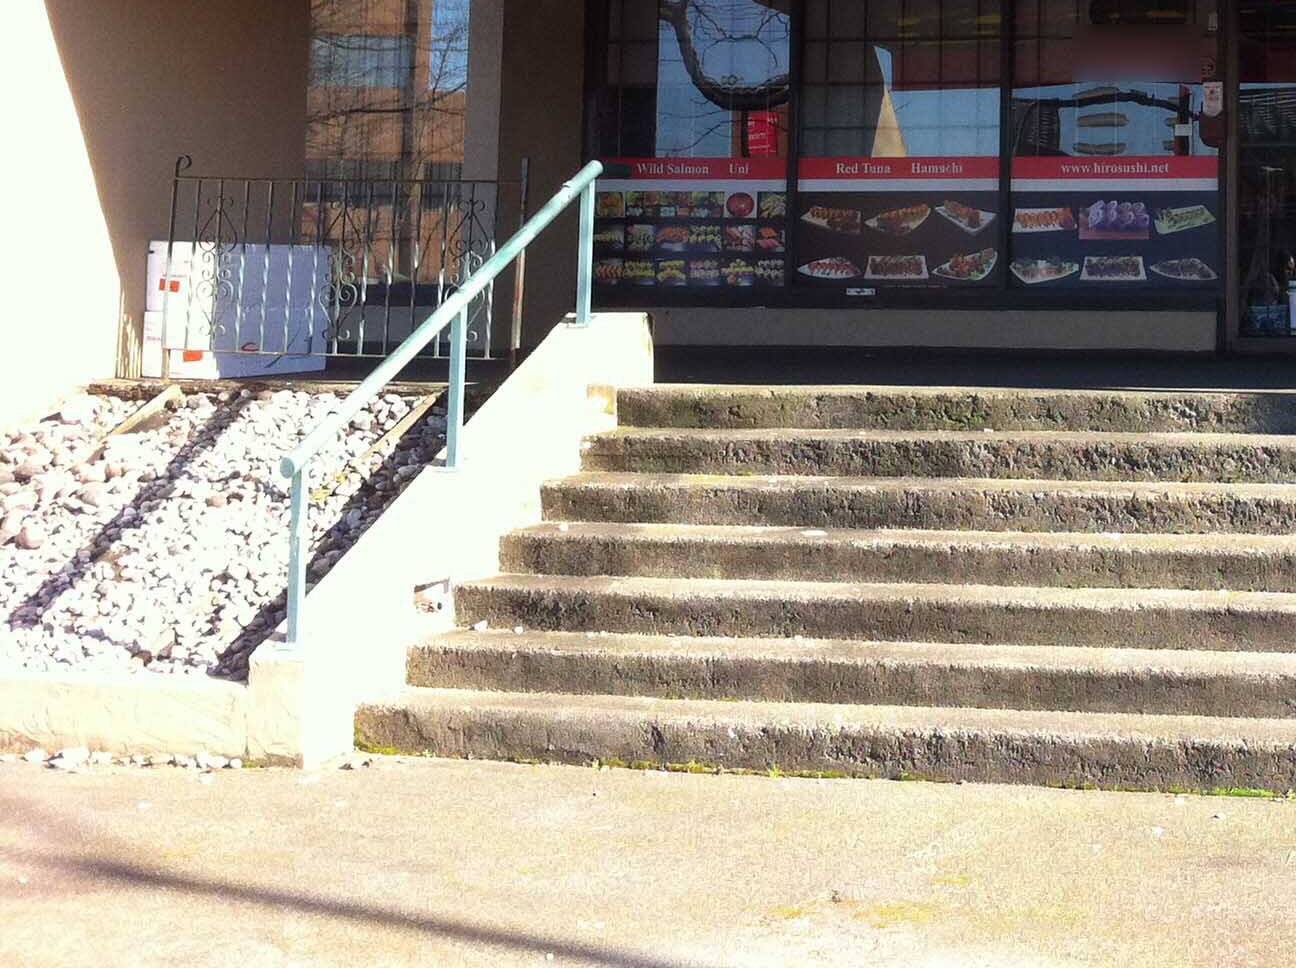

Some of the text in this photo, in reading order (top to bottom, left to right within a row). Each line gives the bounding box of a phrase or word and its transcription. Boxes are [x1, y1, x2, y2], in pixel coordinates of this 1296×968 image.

[637, 162, 709, 175] Wild Salmon
[729, 162, 749, 175] Uni
[836, 162, 891, 175] Red Tuna
[1060, 161, 1169, 175] www.hirosushi.net
